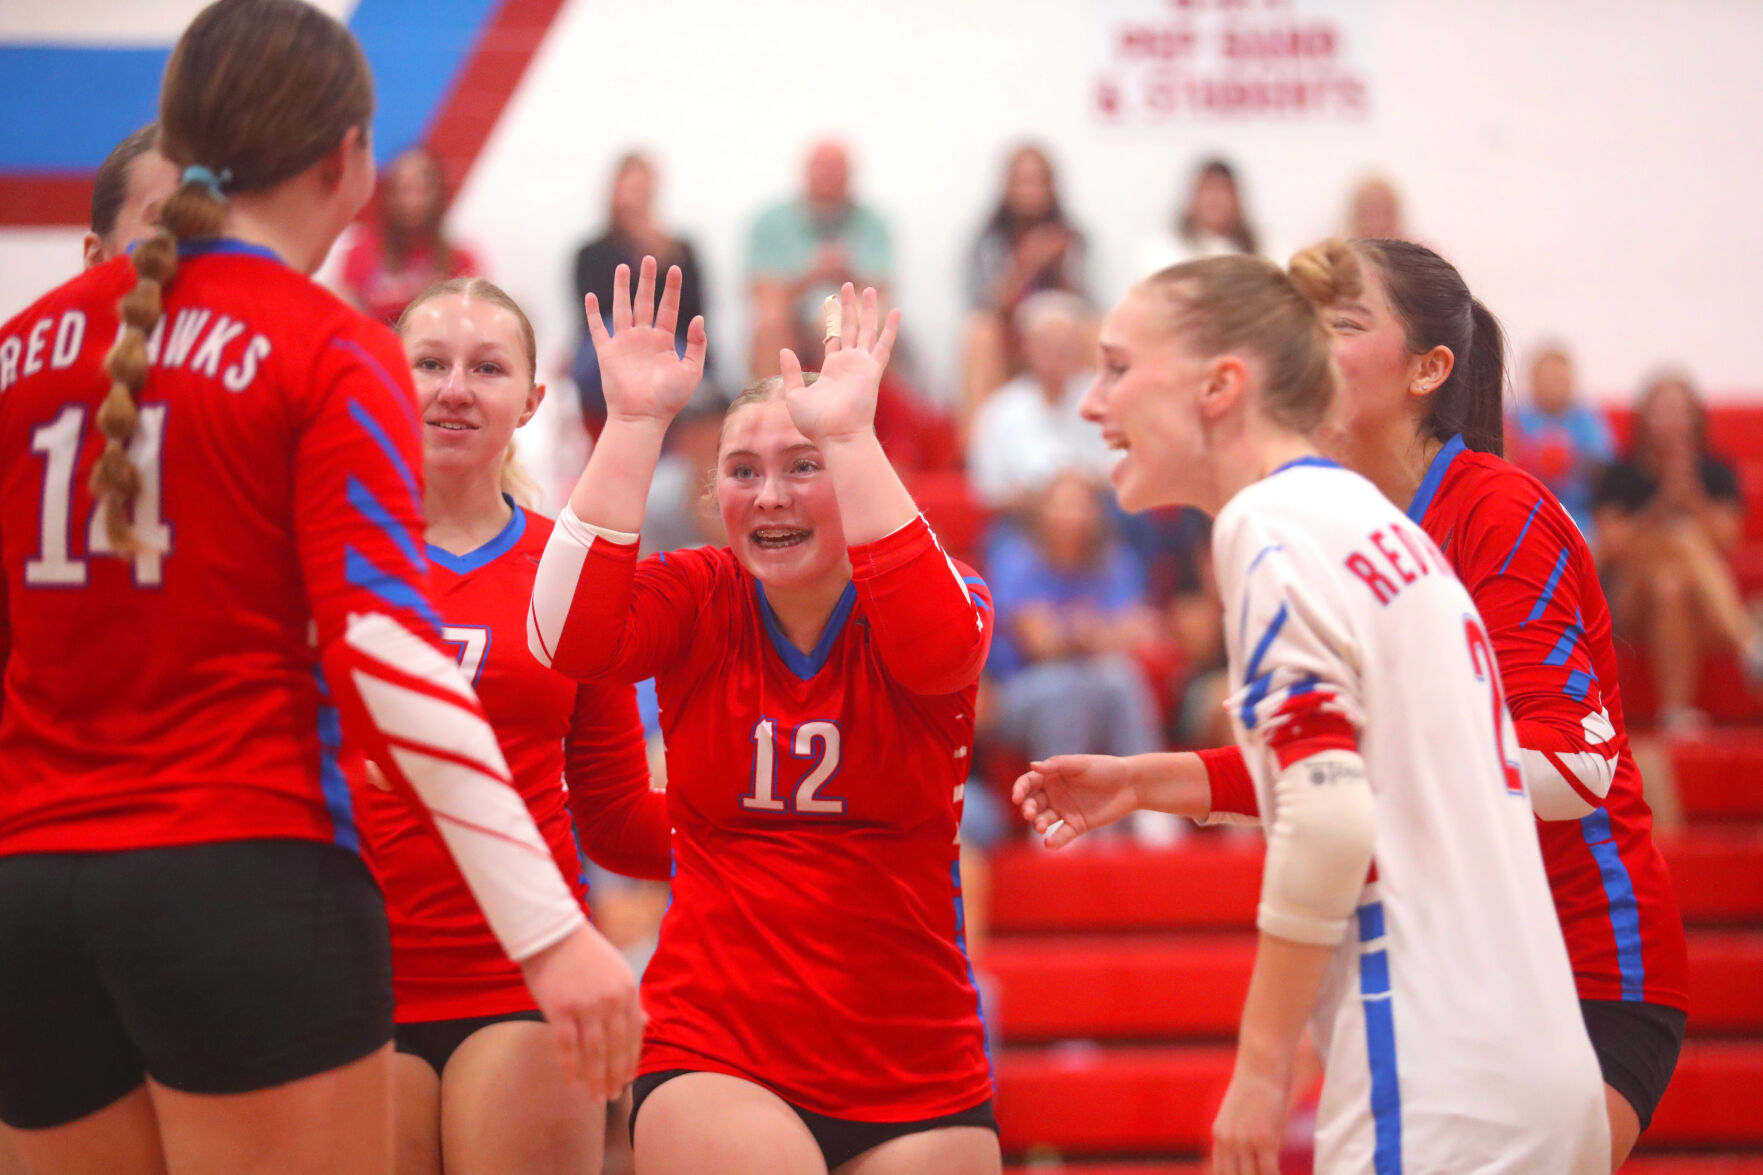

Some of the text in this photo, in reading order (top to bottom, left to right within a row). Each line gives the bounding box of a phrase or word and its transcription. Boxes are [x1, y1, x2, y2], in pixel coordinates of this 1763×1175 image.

[0, 308, 272, 394] RED AWKS
[25, 402, 175, 590] 14
[738, 715, 847, 814] 12
[1463, 612, 1525, 797] 2
